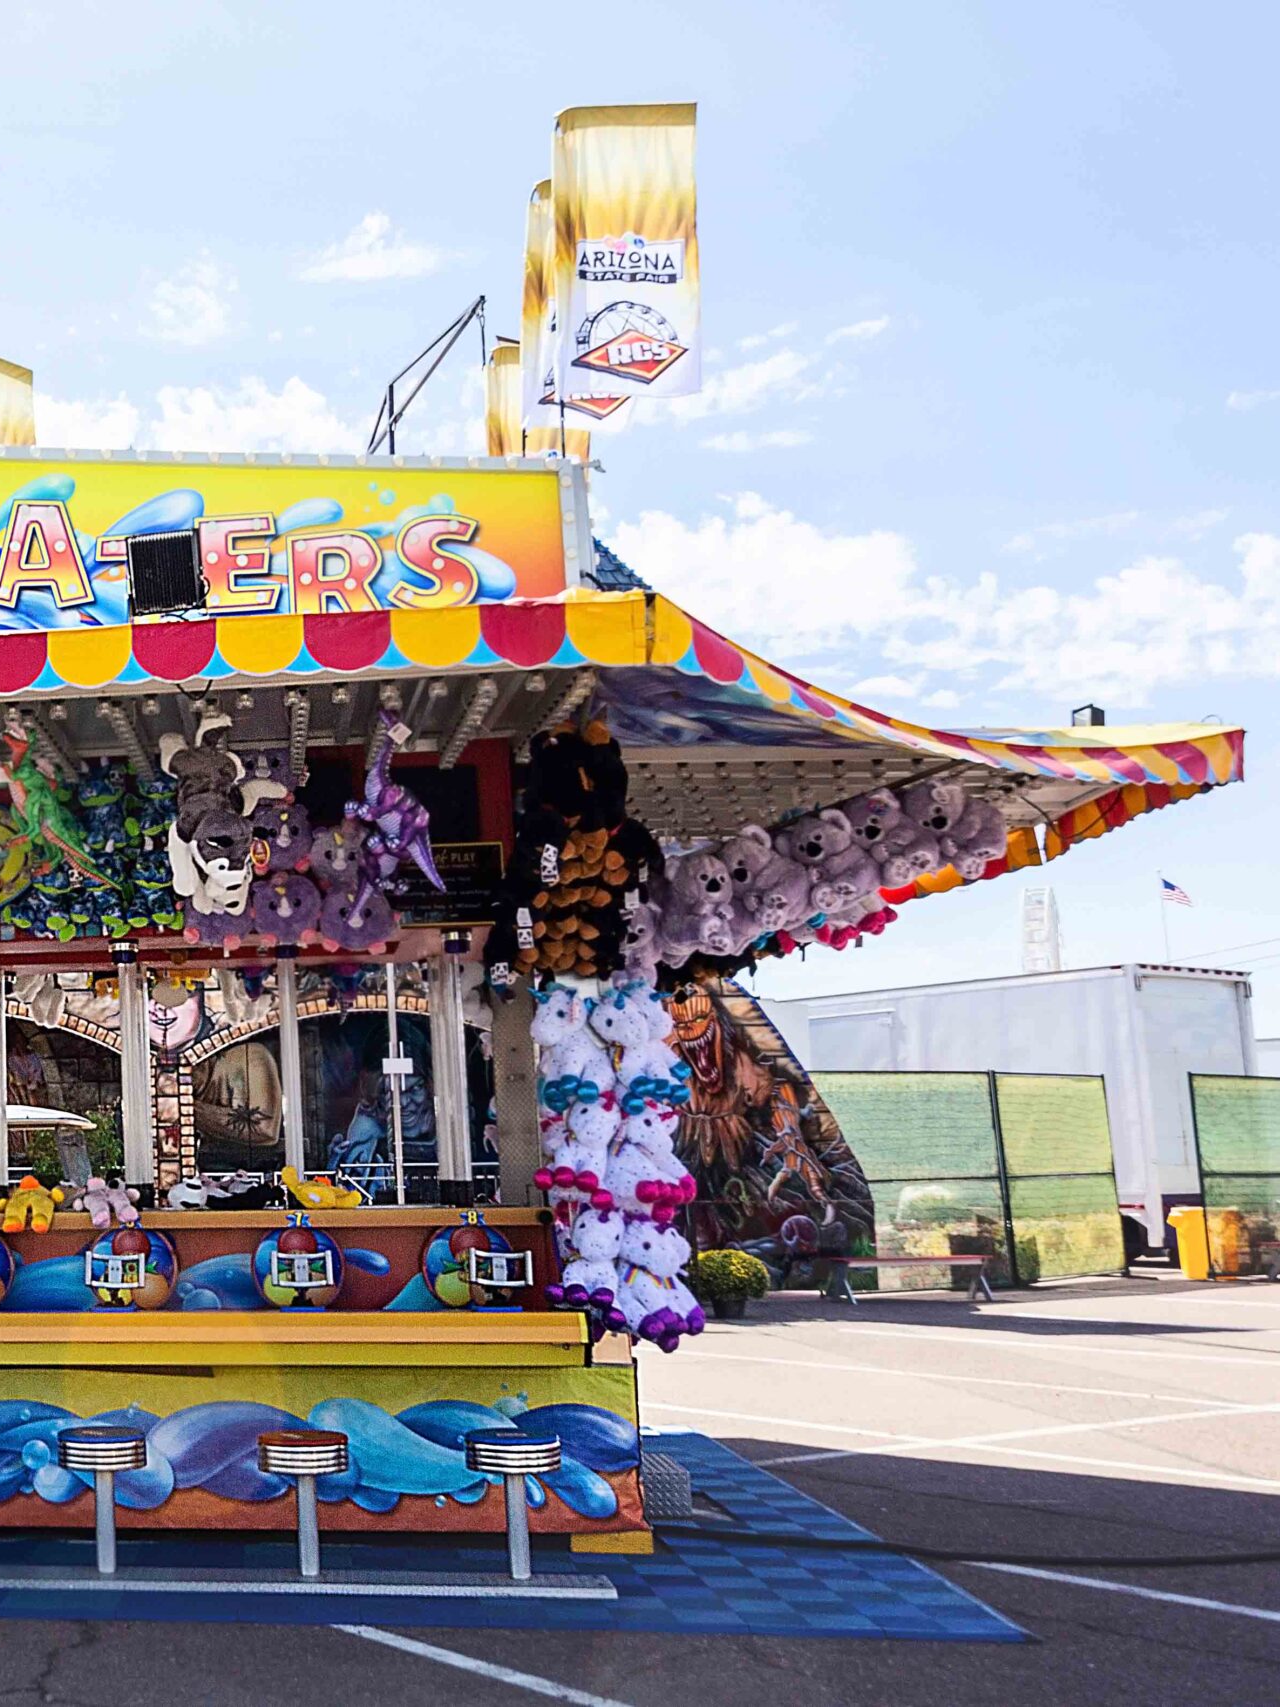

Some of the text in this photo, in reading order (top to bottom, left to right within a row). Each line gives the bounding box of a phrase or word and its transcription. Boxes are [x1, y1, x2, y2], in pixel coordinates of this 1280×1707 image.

[579, 250, 676, 270] ARIZONA
[585, 271, 670, 284] STATE FAIR
[606, 341, 671, 366] RCS
[450, 852, 475, 862] PLAY
[467, 1210, 478, 1225] 8
